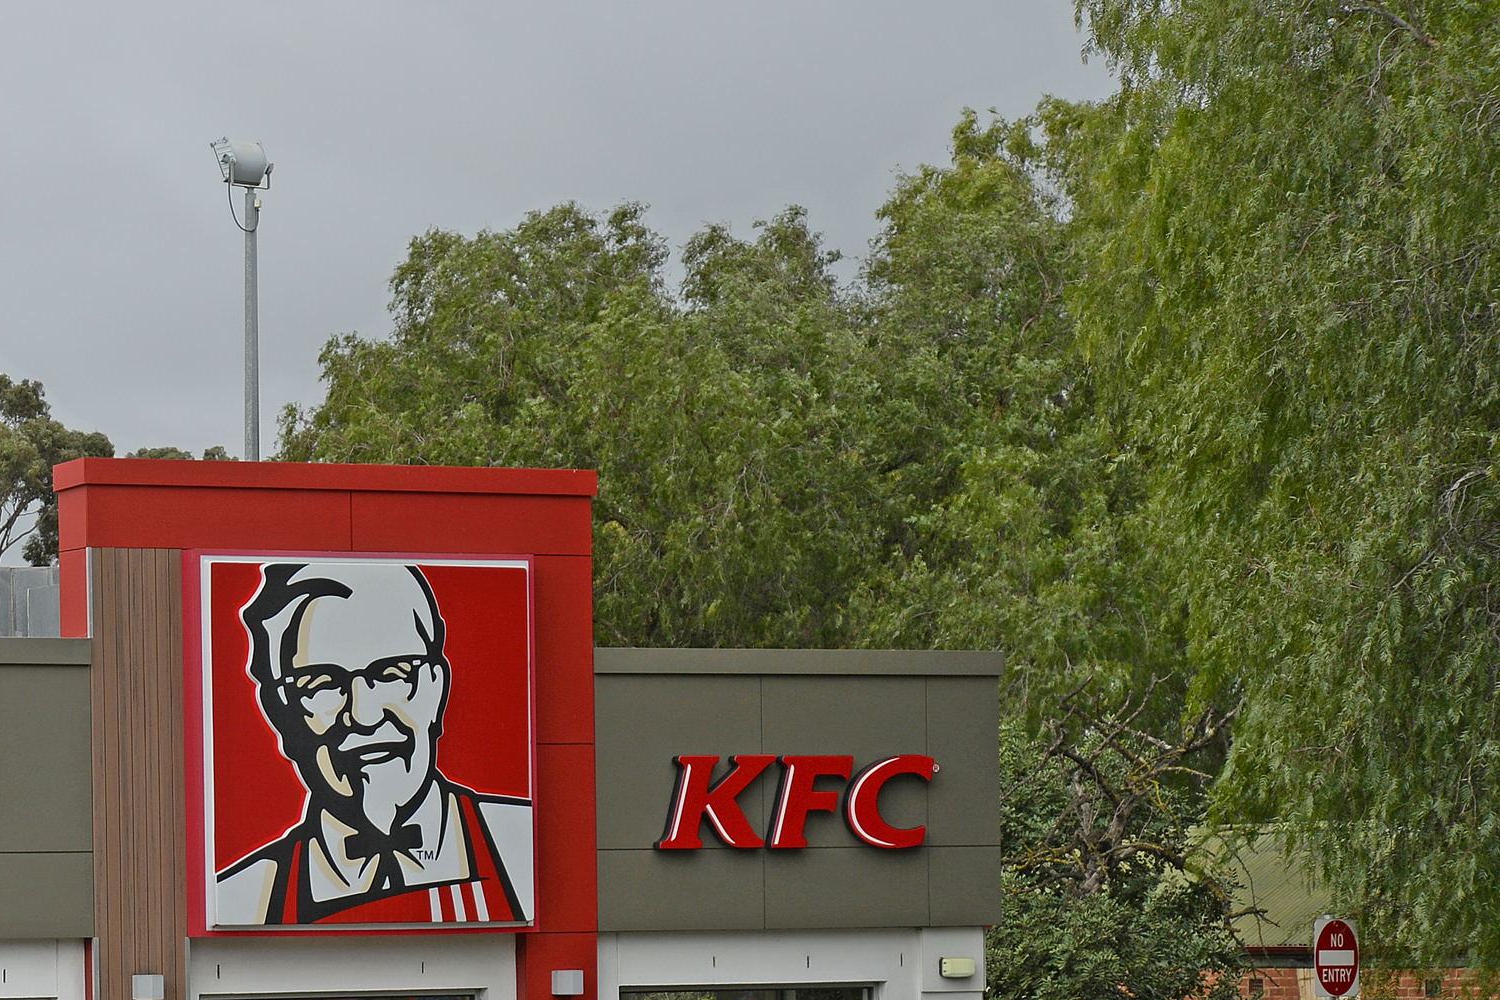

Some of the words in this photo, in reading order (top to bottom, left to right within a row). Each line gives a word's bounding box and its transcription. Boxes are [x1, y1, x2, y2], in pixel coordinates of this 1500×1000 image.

[654, 754, 935, 849] KFC
[416, 850, 434, 860] TM
[1330, 934, 1344, 947] NO
[1322, 968, 1352, 983] ENTRY
